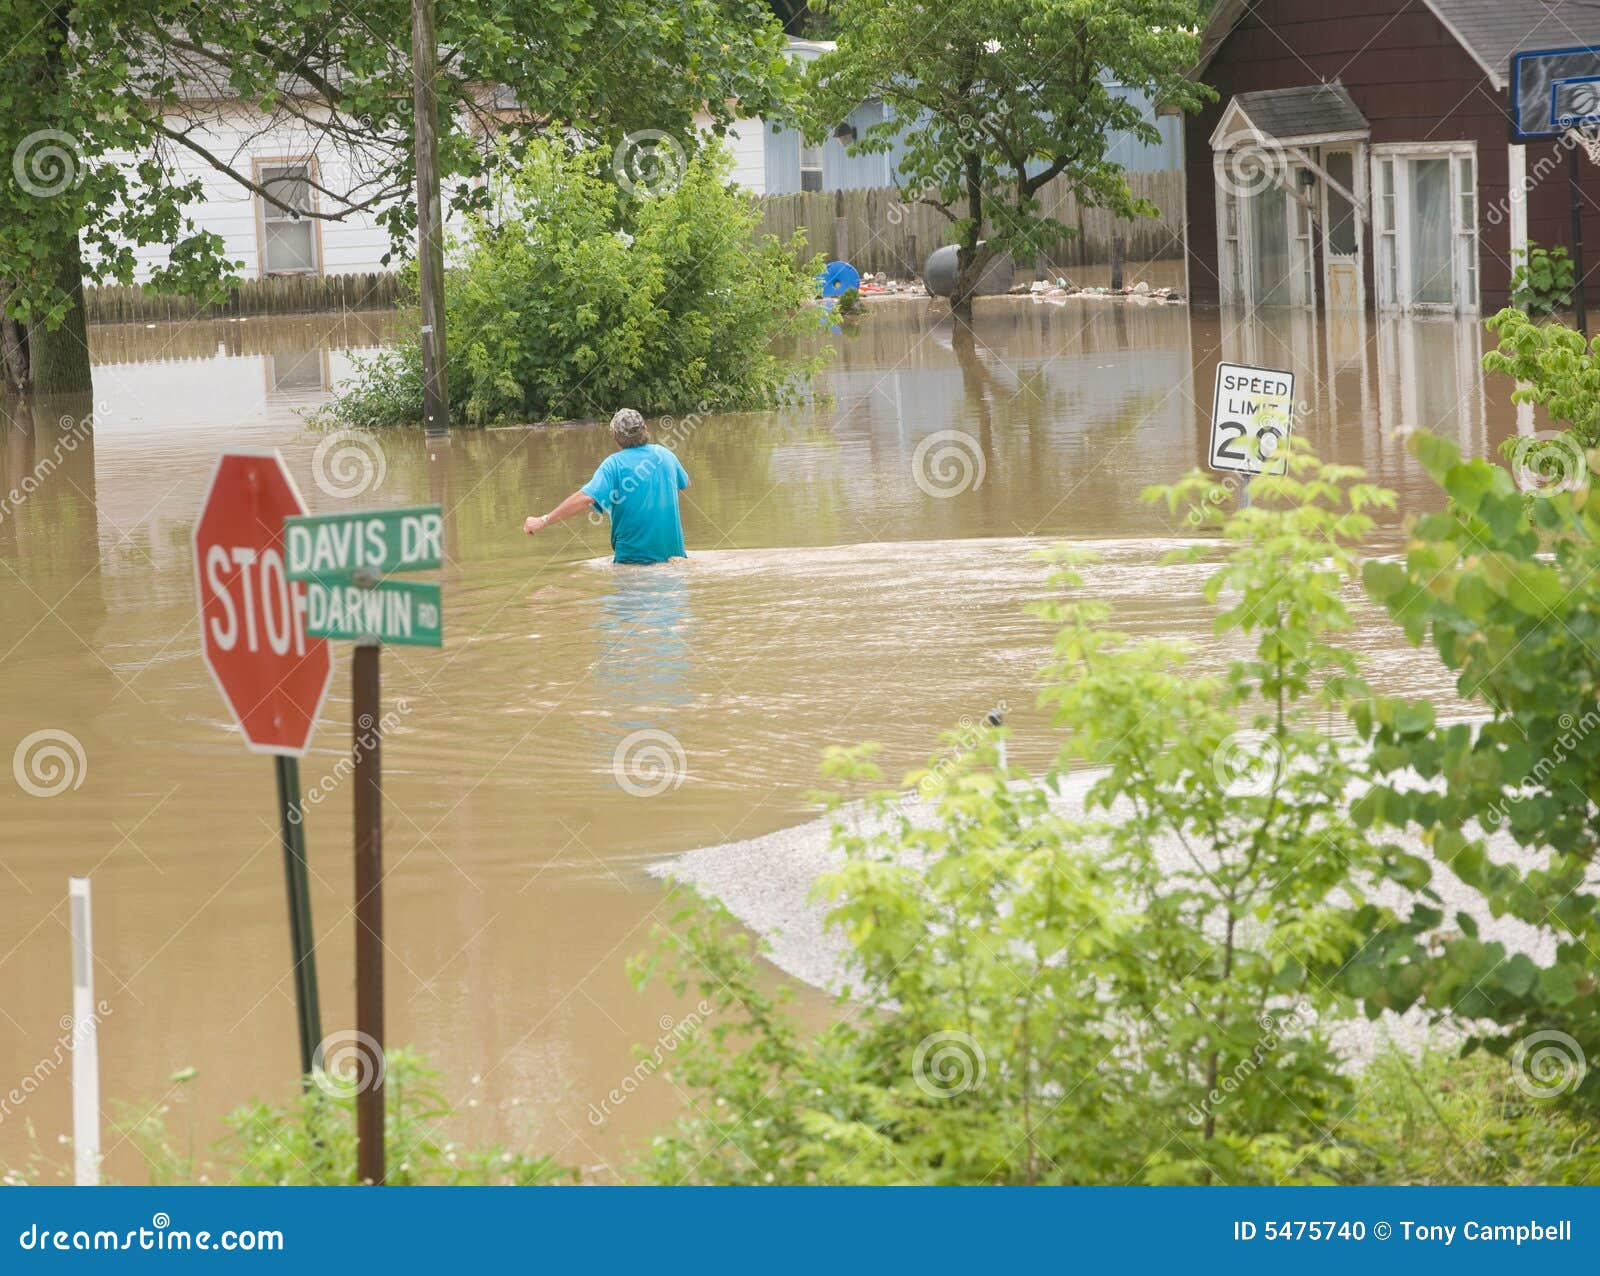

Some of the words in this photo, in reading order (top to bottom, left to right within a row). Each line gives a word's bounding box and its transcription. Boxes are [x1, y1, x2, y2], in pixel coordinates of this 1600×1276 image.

[1224, 376, 1288, 396] SPEED
[1217, 421, 1283, 462] 20
[288, 519, 387, 573] DAVIS
[401, 514, 441, 564] DR
[309, 584, 412, 638] DARWIN
[417, 603, 438, 629] RD
